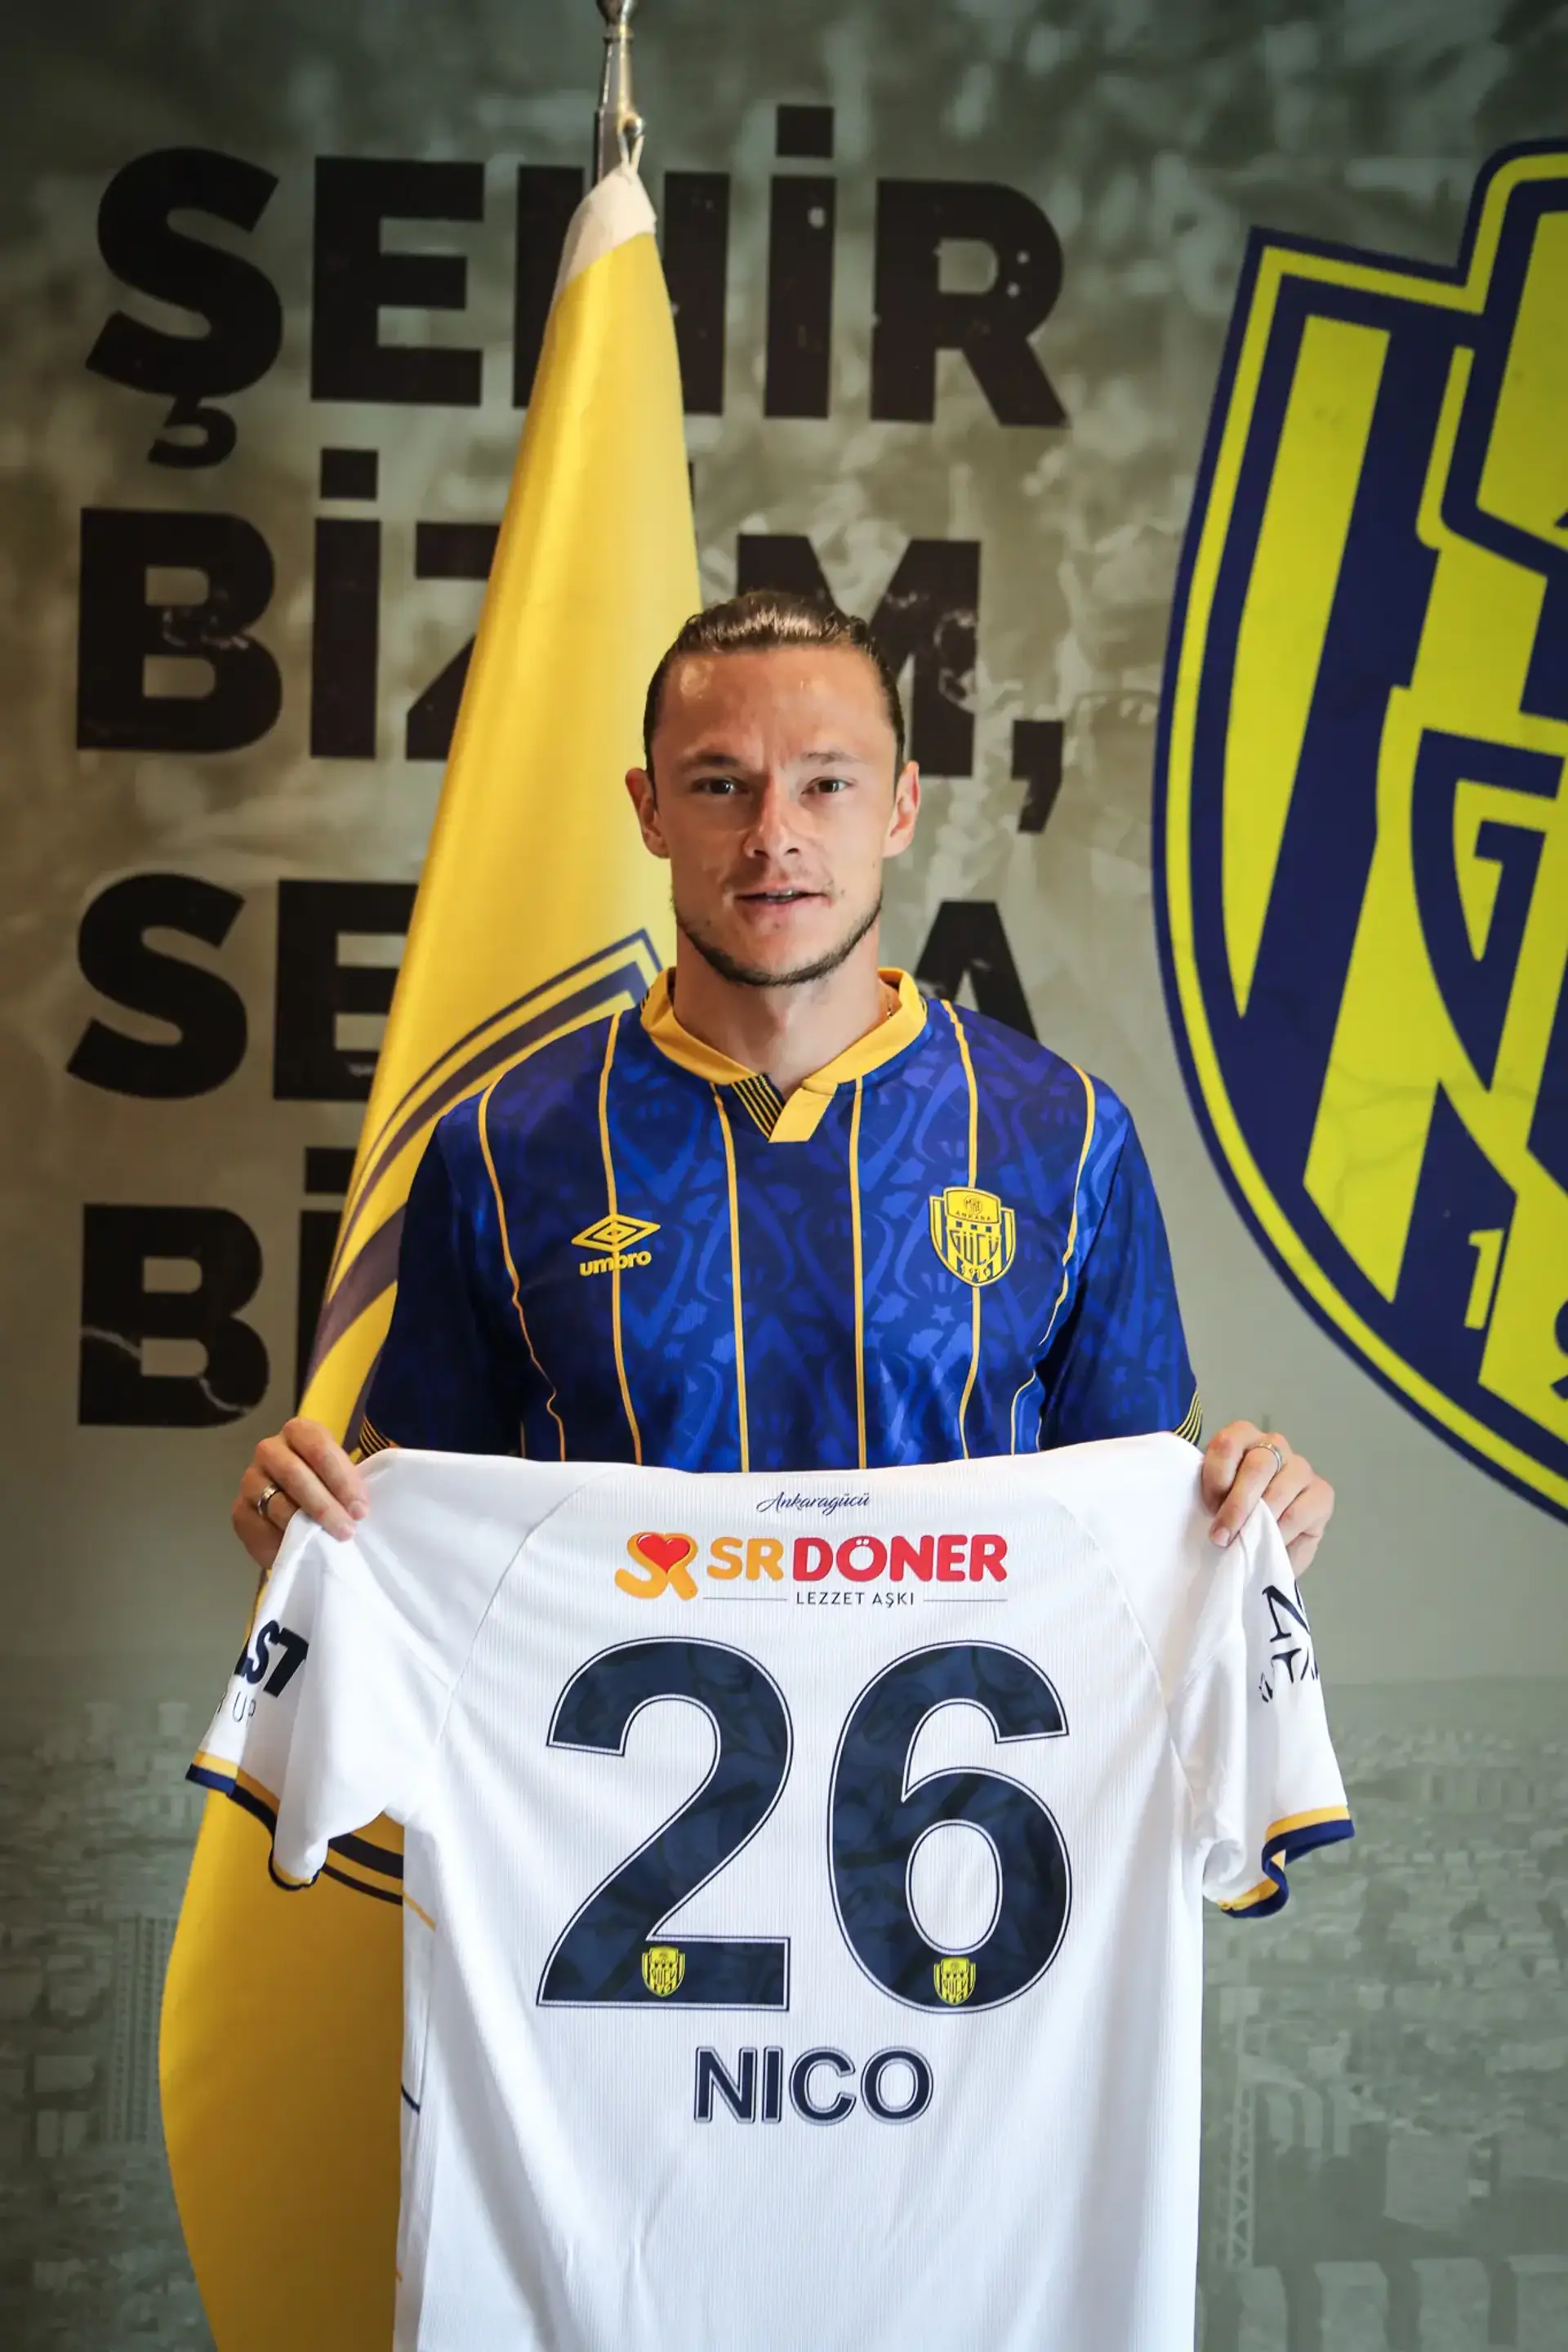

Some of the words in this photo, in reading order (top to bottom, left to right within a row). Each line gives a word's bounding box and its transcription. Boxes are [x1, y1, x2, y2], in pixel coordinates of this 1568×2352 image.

[66, 873, 1039, 1102] SEA
[580, 1250, 652, 1276] umbro
[756, 1491, 871, 1516] Ankaragücü
[793, 1534, 1008, 1583] DÖNER
[796, 1592, 866, 1606] LEZZET
[871, 1591, 915, 1608] AŞKI
[536, 1636, 1072, 2014] 26
[693, 2047, 934, 2127] NICO
